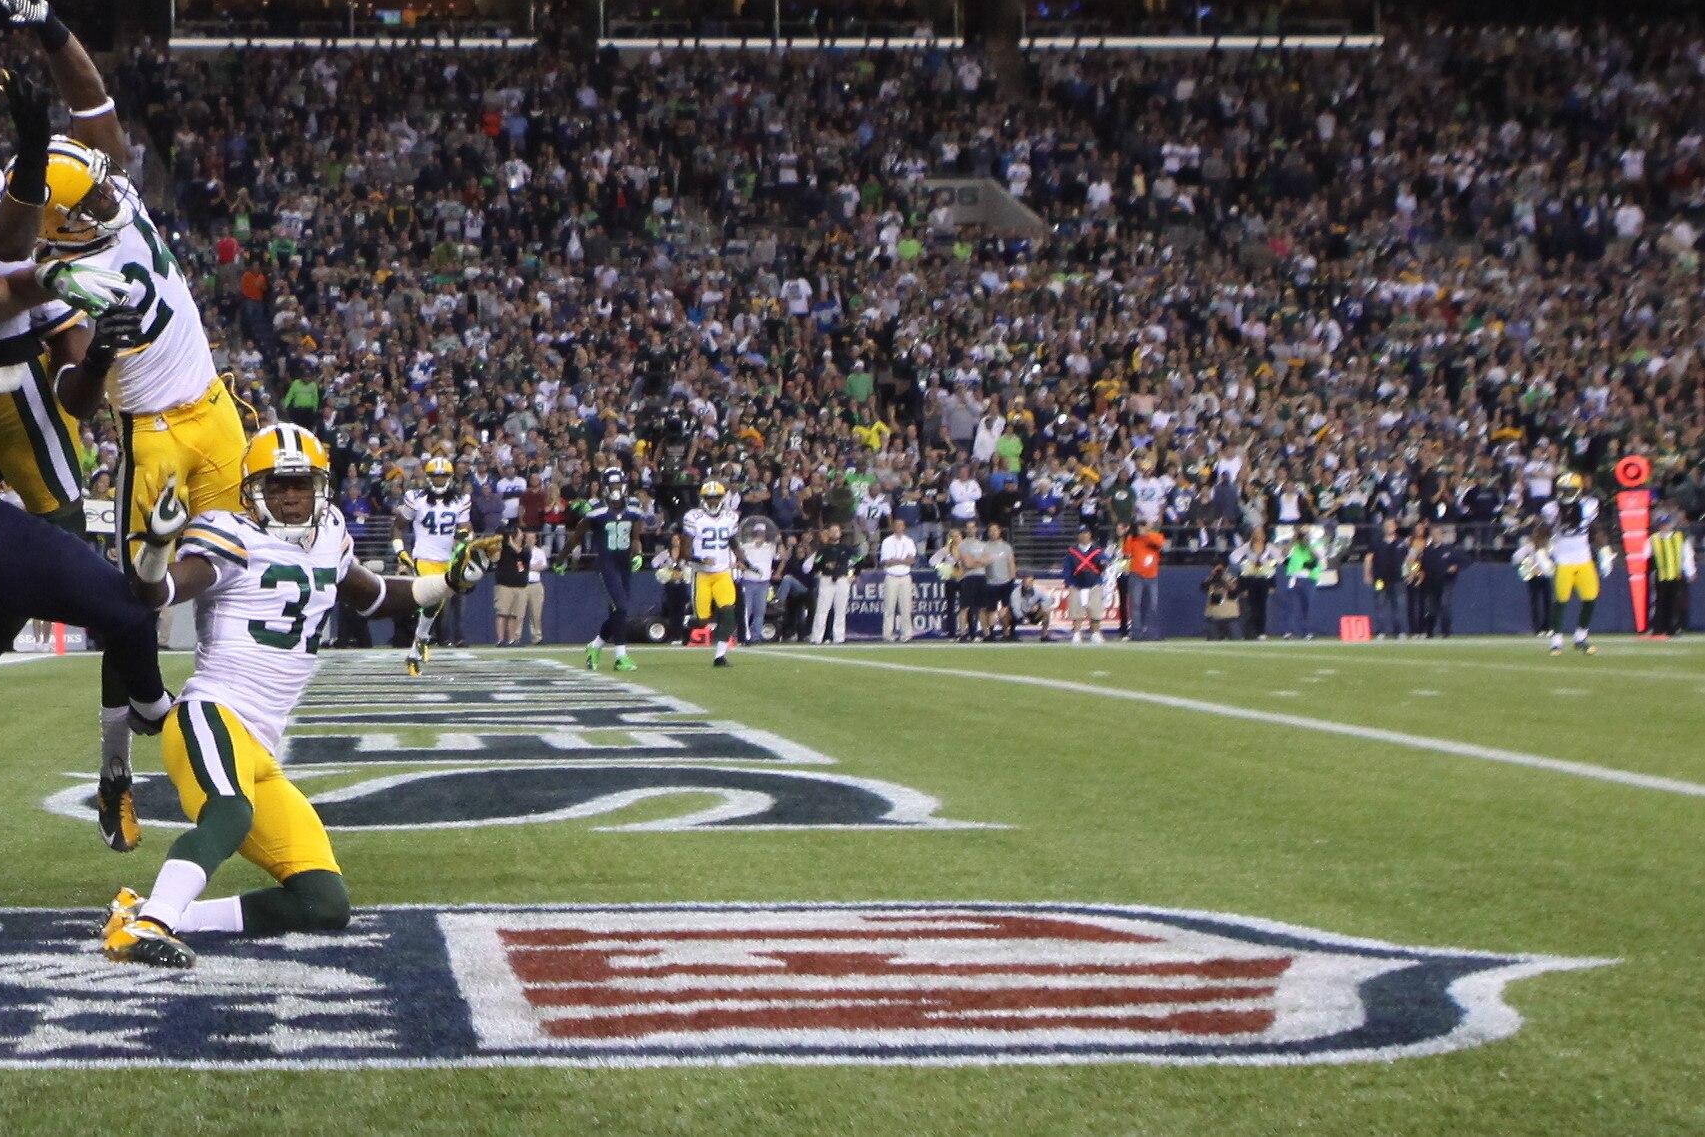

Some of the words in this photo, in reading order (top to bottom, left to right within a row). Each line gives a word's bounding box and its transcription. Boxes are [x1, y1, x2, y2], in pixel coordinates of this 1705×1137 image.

[422, 511, 457, 536] 42
[604, 521, 633, 551] 18
[701, 527, 731, 550] 29
[247, 564, 338, 655] 37
